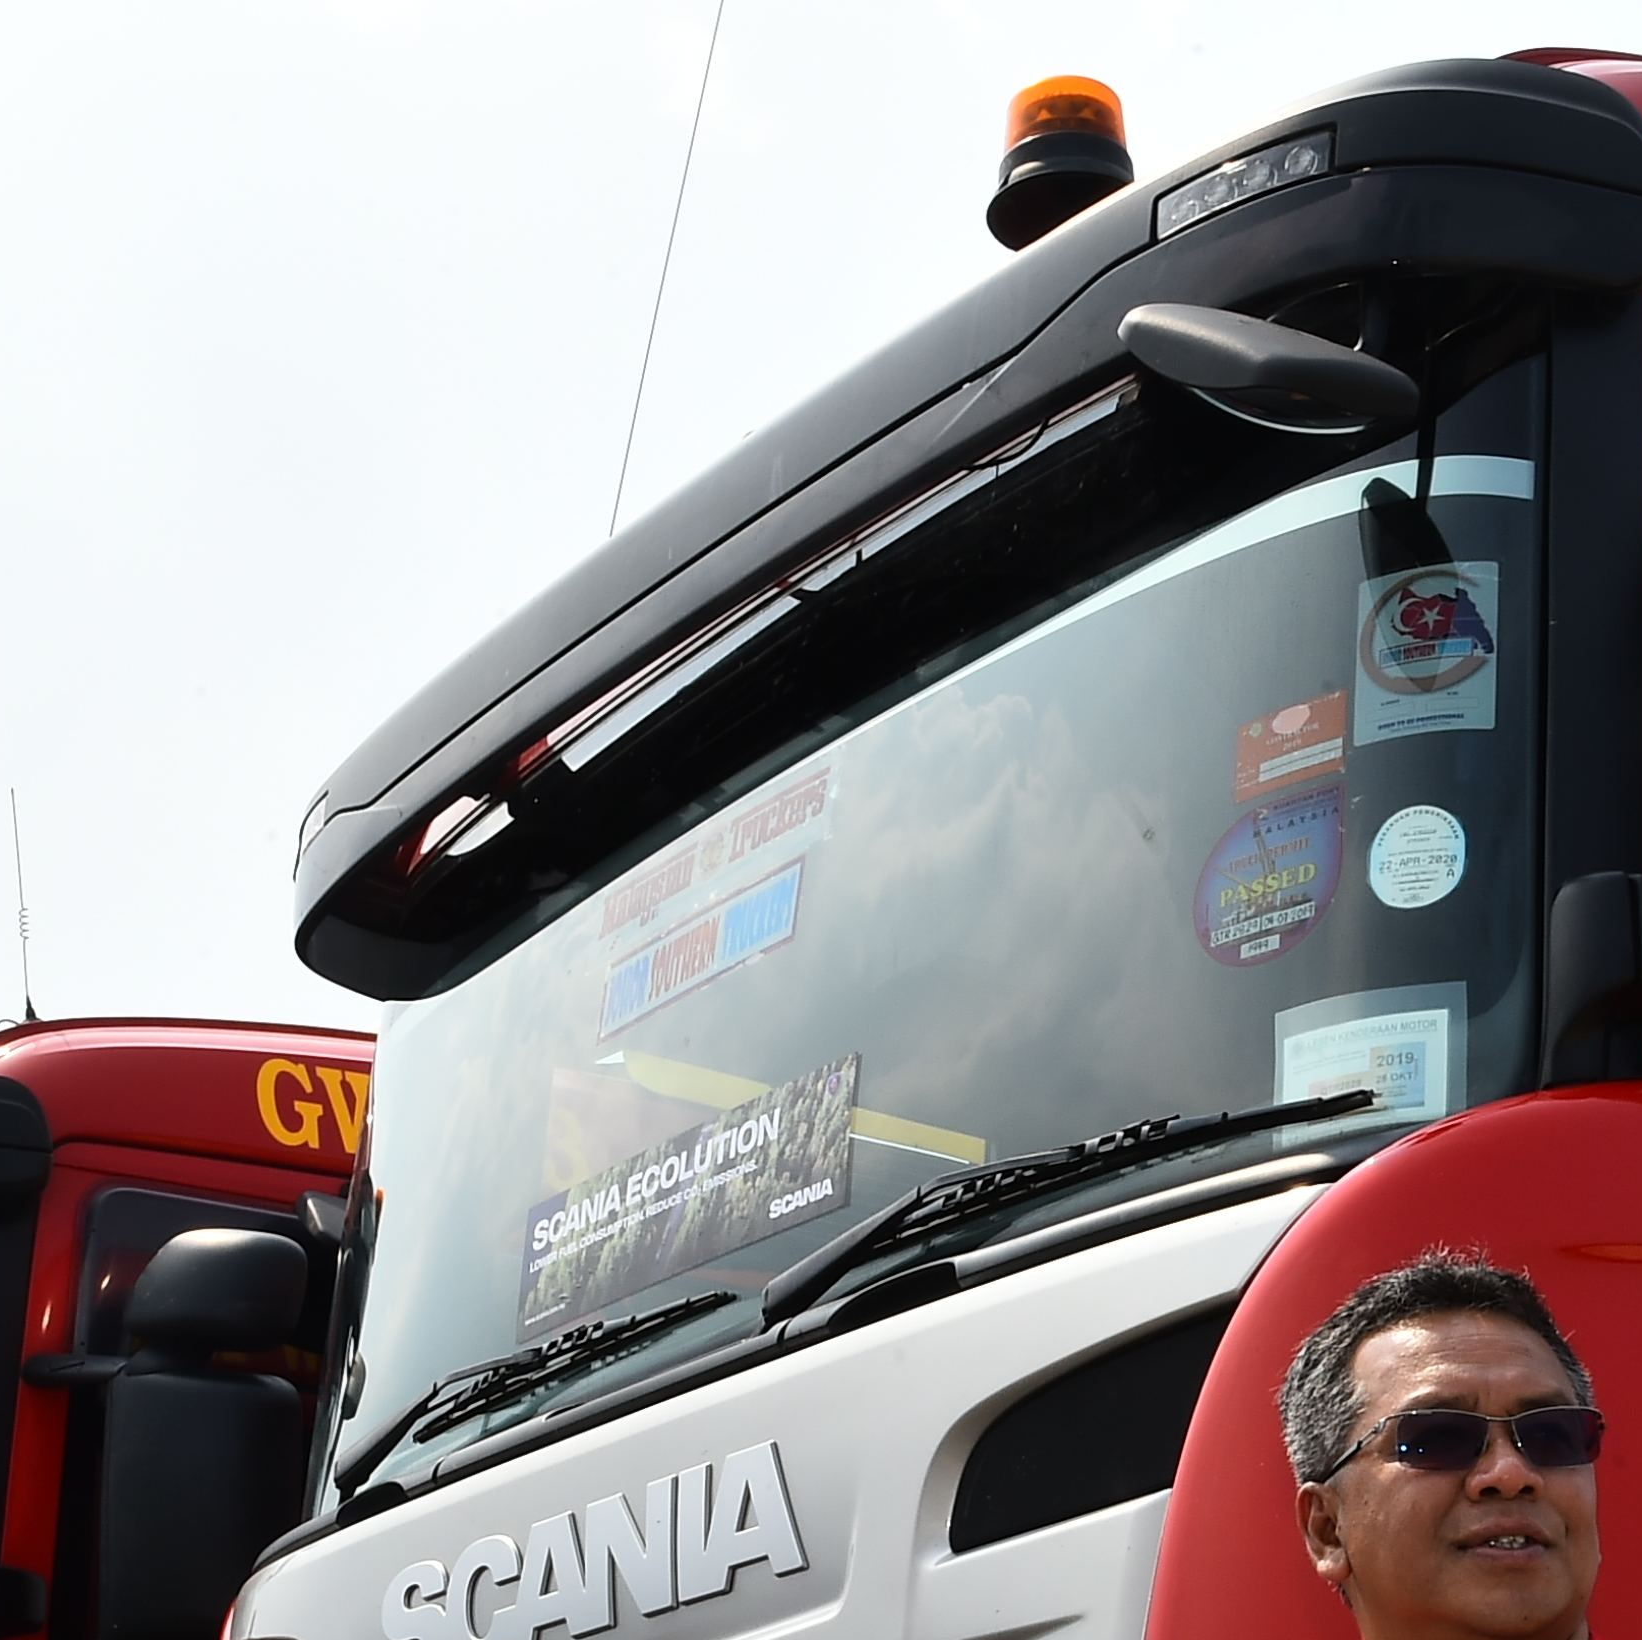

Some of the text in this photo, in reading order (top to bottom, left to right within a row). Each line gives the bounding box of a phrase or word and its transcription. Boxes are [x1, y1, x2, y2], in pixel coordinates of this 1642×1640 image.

[1253, 806, 1340, 838] MALAYSIA
[1379, 854, 1458, 872] 22-APR-2020
[1220, 863, 1317, 908] PASSED
[1399, 1019, 1438, 1032] MOTOR
[1376, 1052, 1414, 1068] 2019
[532, 1107, 781, 1251] SCANIA ECOLUTION
[768, 1178, 834, 1220] SCANIA
